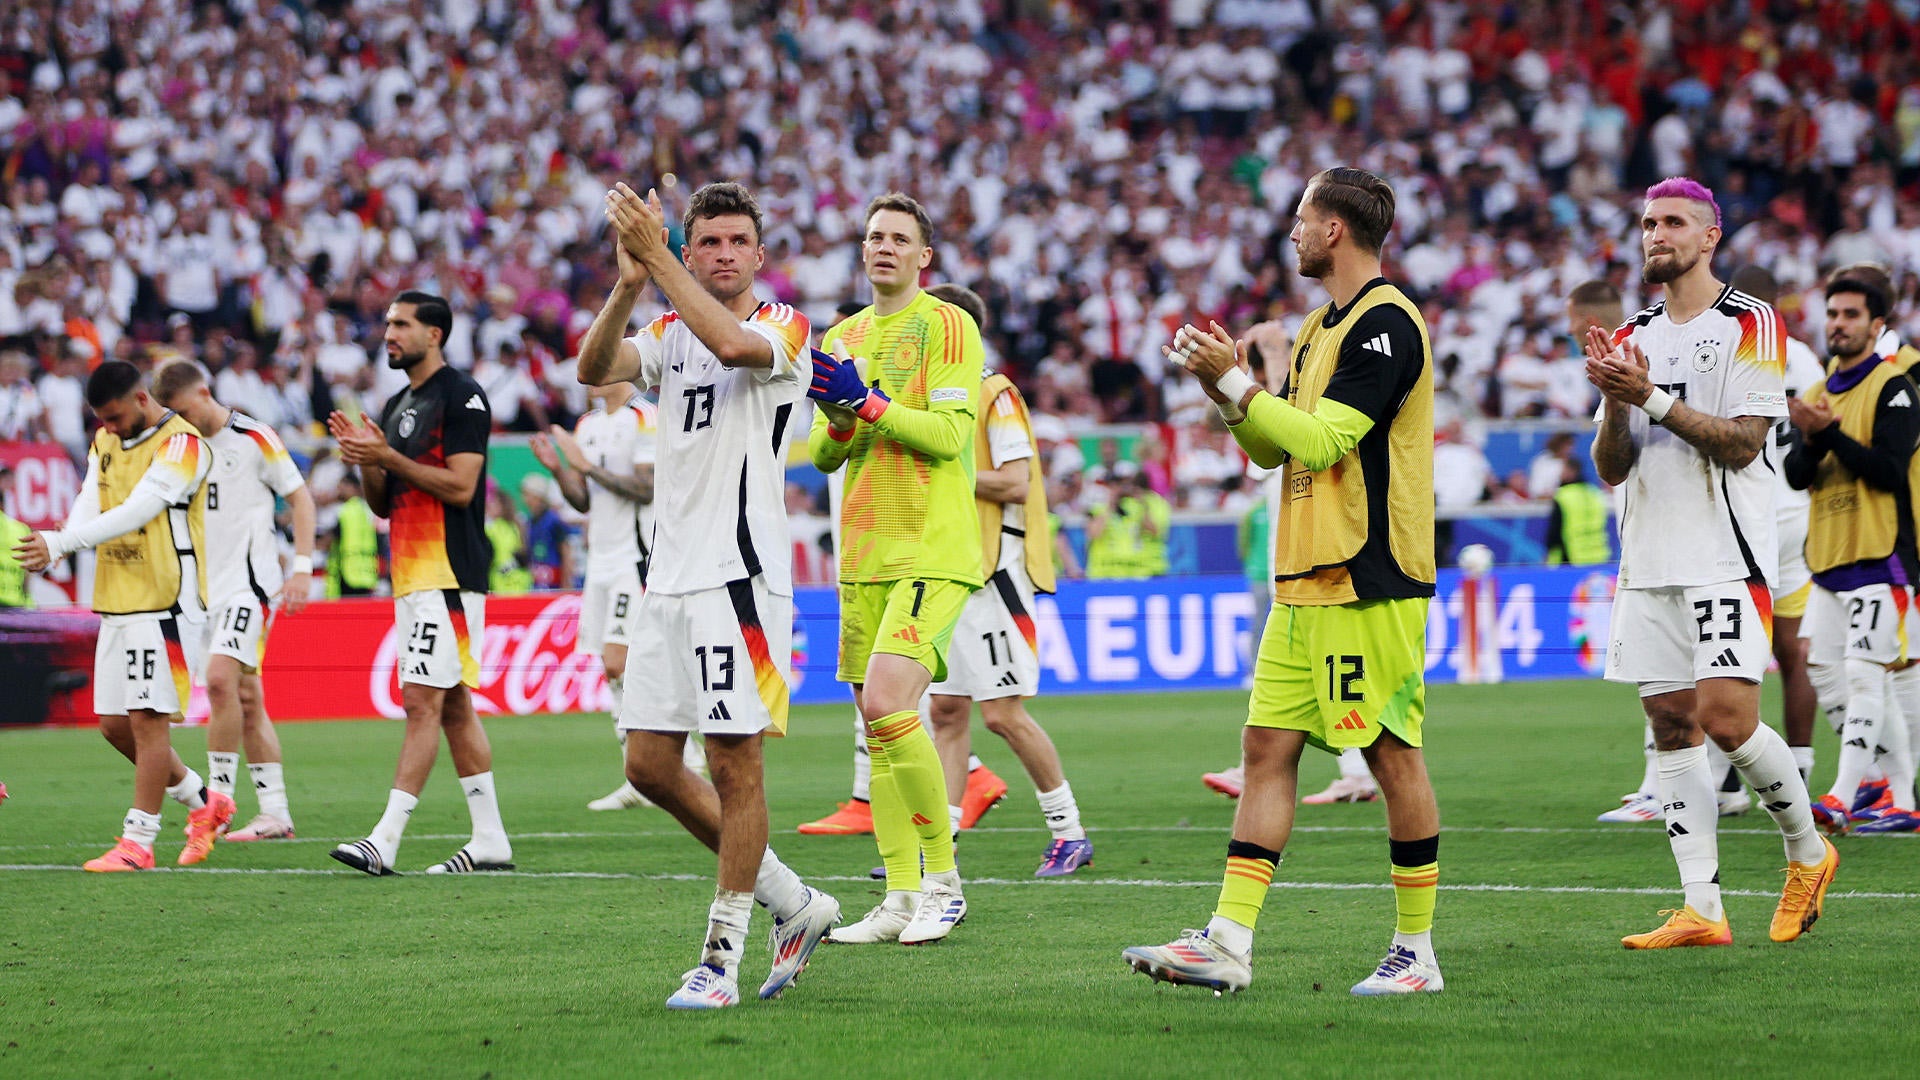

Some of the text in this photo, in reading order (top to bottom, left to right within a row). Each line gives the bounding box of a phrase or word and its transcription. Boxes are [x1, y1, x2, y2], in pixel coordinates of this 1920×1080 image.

[682, 384, 716, 432] 13
[615, 593, 630, 618] 8
[911, 581, 926, 618] 1
[1850, 597, 1882, 630] 21
[223, 606, 252, 633] 18
[1693, 598, 1741, 643] 23
[126, 649, 156, 680] 26
[982, 630, 1013, 666] 11
[695, 646, 735, 692] 13
[1326, 655, 1365, 703] 12
